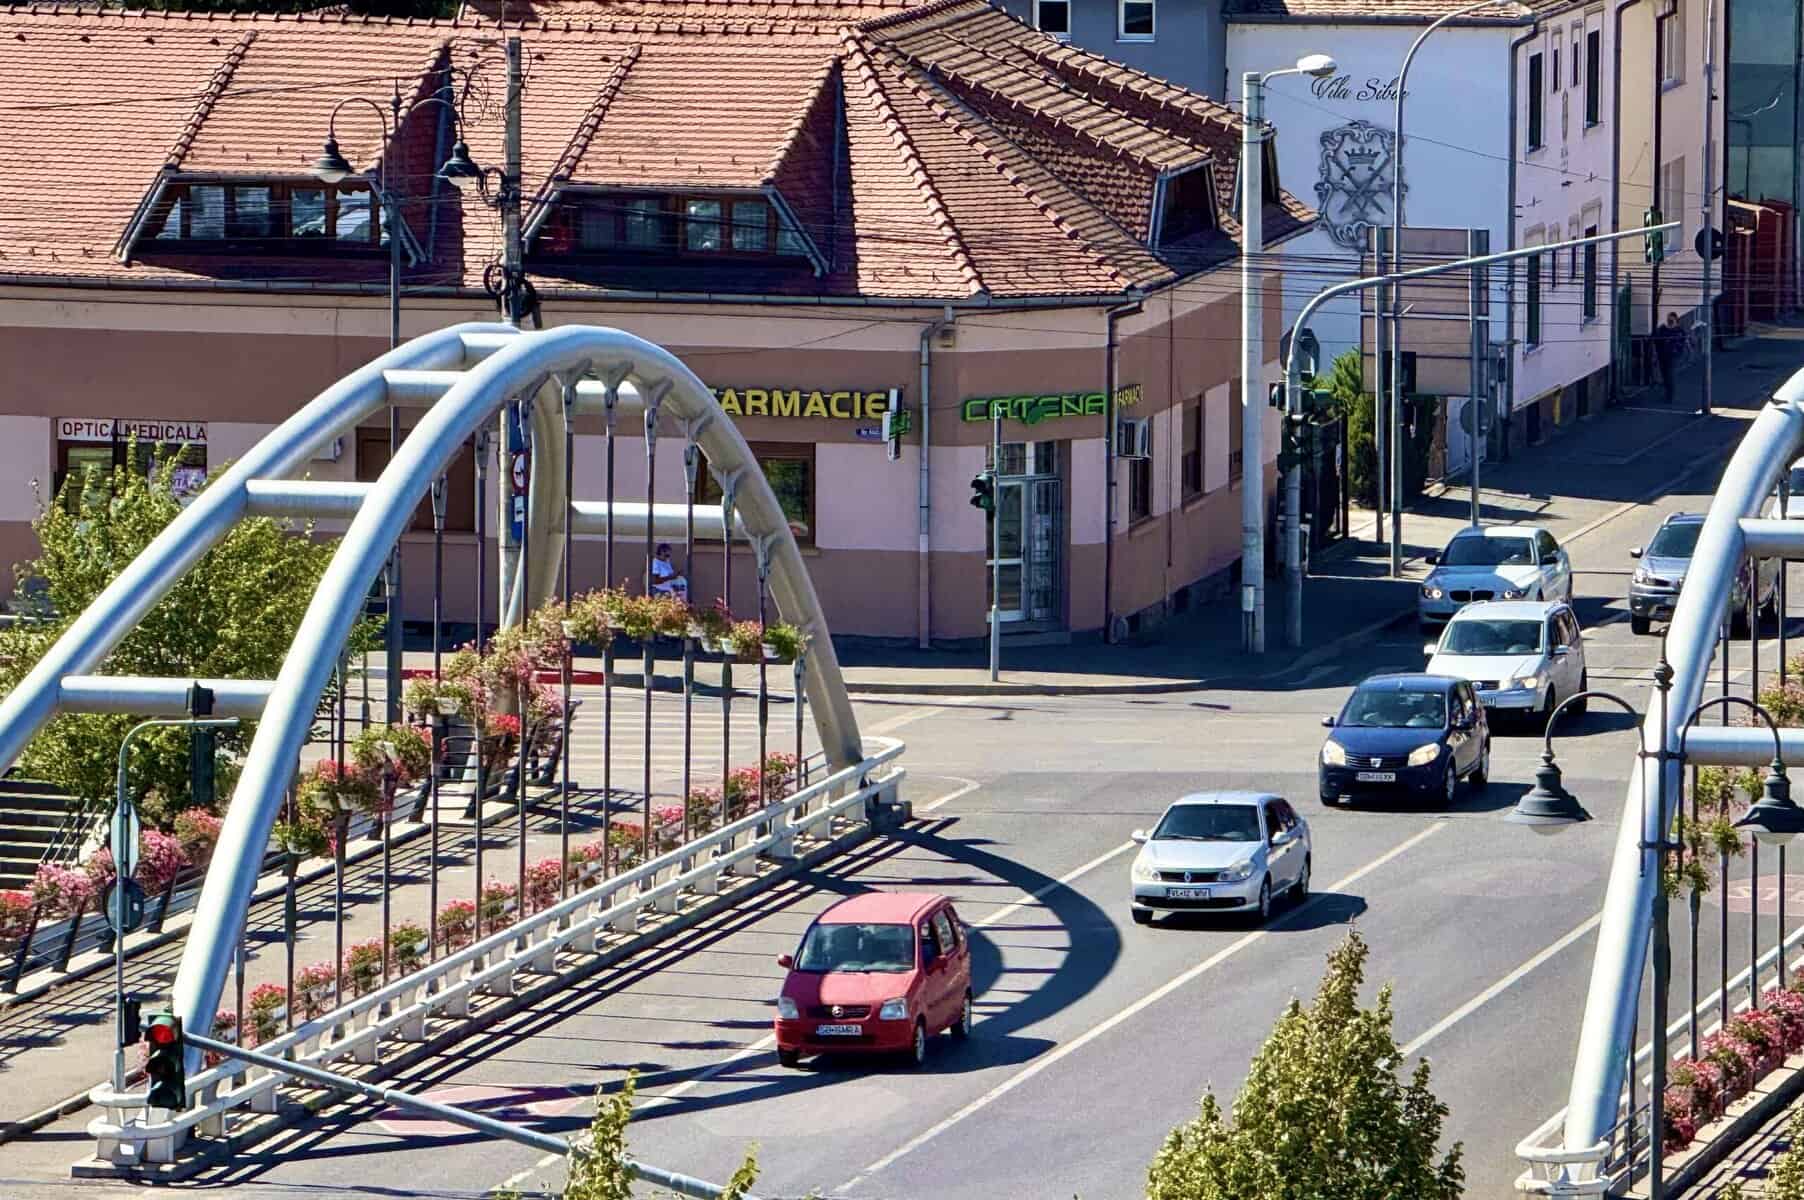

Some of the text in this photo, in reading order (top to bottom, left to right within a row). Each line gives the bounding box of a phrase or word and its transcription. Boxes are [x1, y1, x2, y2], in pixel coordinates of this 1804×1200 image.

[706, 388, 887, 420] ARMACIE
[966, 394, 1106, 421] CATENA
[63, 422, 115, 437] OPTIC
